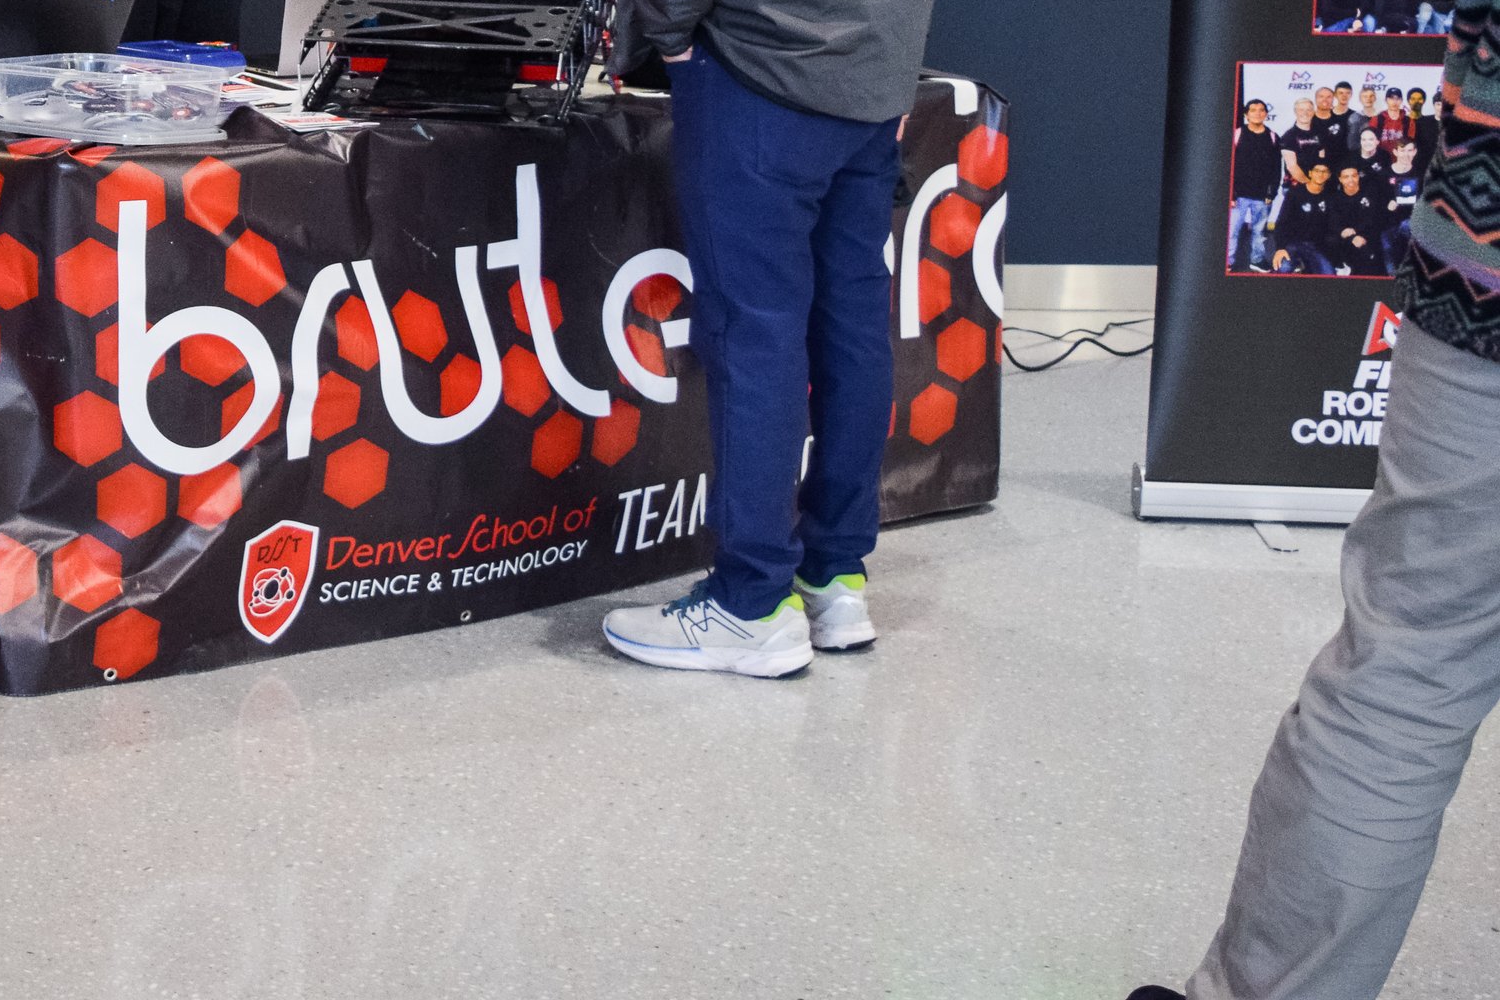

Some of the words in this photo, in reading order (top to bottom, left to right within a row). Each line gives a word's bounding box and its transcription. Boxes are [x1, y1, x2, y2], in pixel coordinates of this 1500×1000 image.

[1288, 82, 1315, 91] FIRST
[1362, 83, 1388, 91] FIRST
[118, 163, 694, 475] brute
[326, 534, 445, 571] Denver
[447, 504, 557, 560] School
[563, 496, 599, 532] of
[319, 573, 419, 603] SCIENCE
[427, 571, 442, 592] &
[451, 539, 589, 588] TECHNOLOGY
